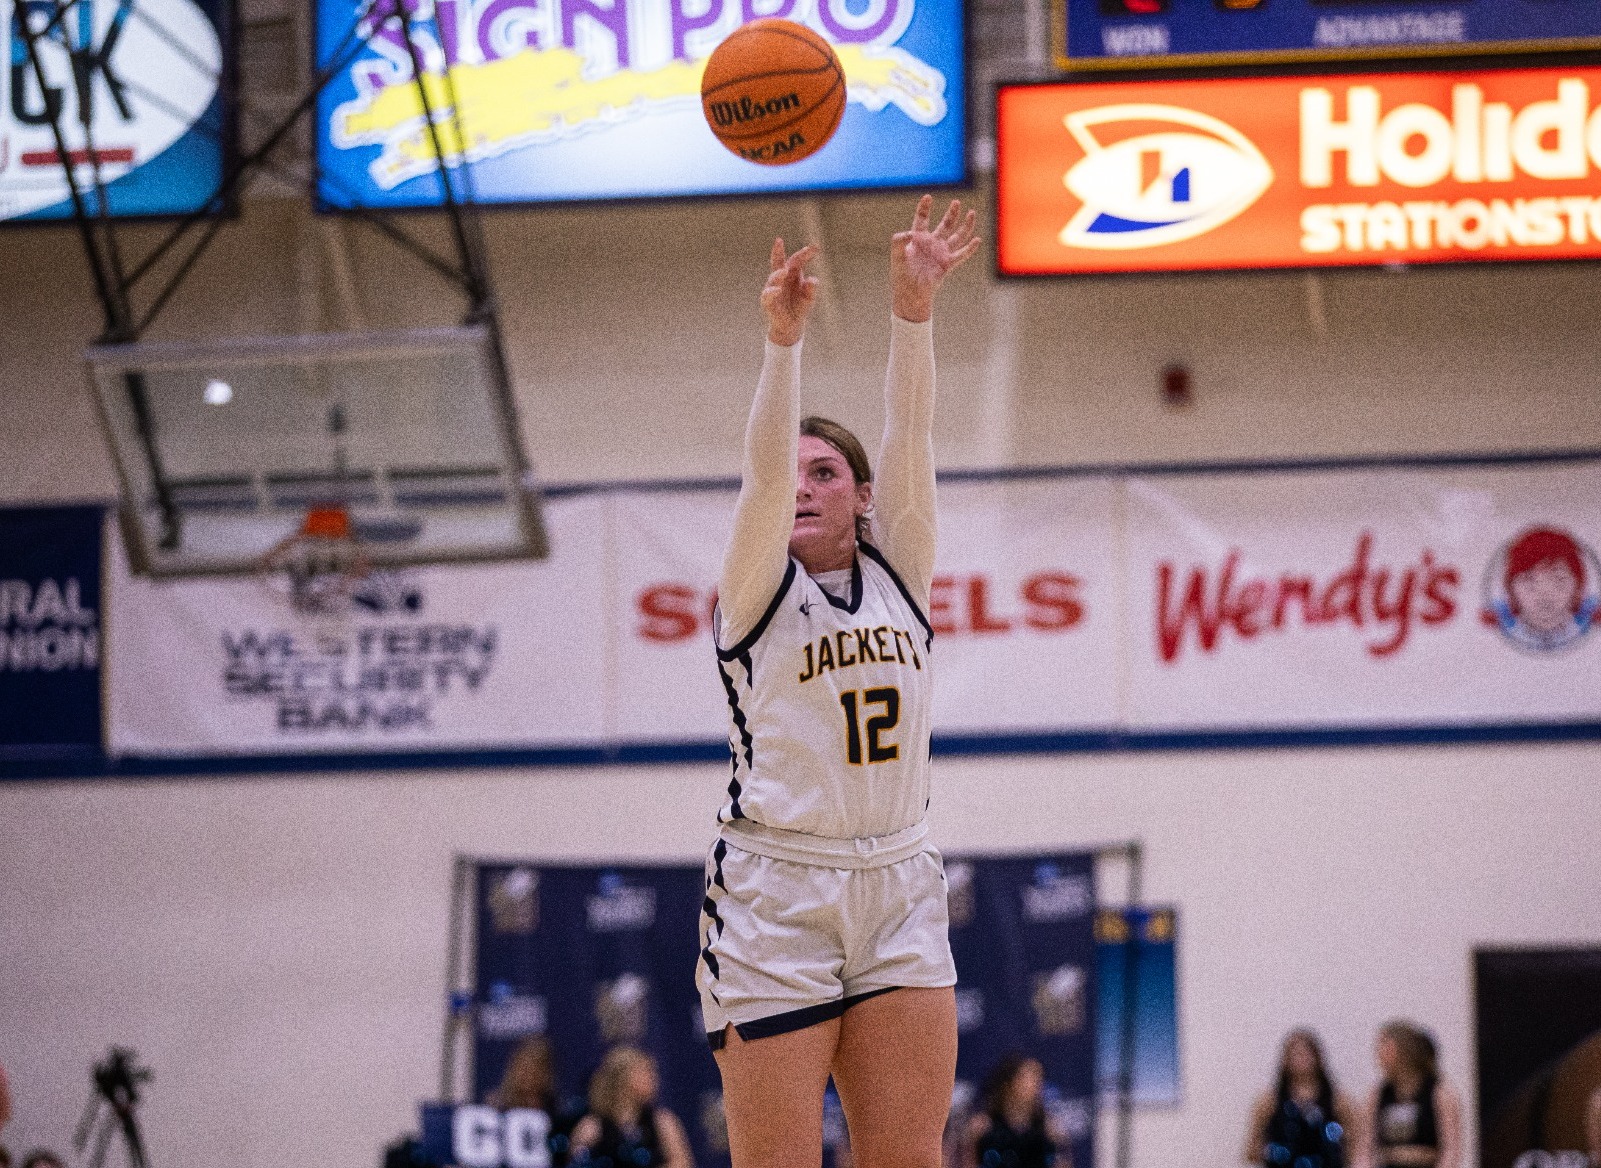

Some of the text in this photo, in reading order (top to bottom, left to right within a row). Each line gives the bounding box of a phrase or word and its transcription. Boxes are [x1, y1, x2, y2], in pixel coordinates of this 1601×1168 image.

[671, 0, 899, 63] PO
[710, 93, 800, 127] Wilson
[1300, 77, 1601, 188] Holid
[1300, 196, 1601, 252] STATIONST
[637, 573, 1086, 643] SELS
[1157, 531, 1460, 664] Wendy's
[223, 659, 494, 694] SECURITY
[276, 697, 434, 732] BANK
[840, 685, 900, 766] 12
